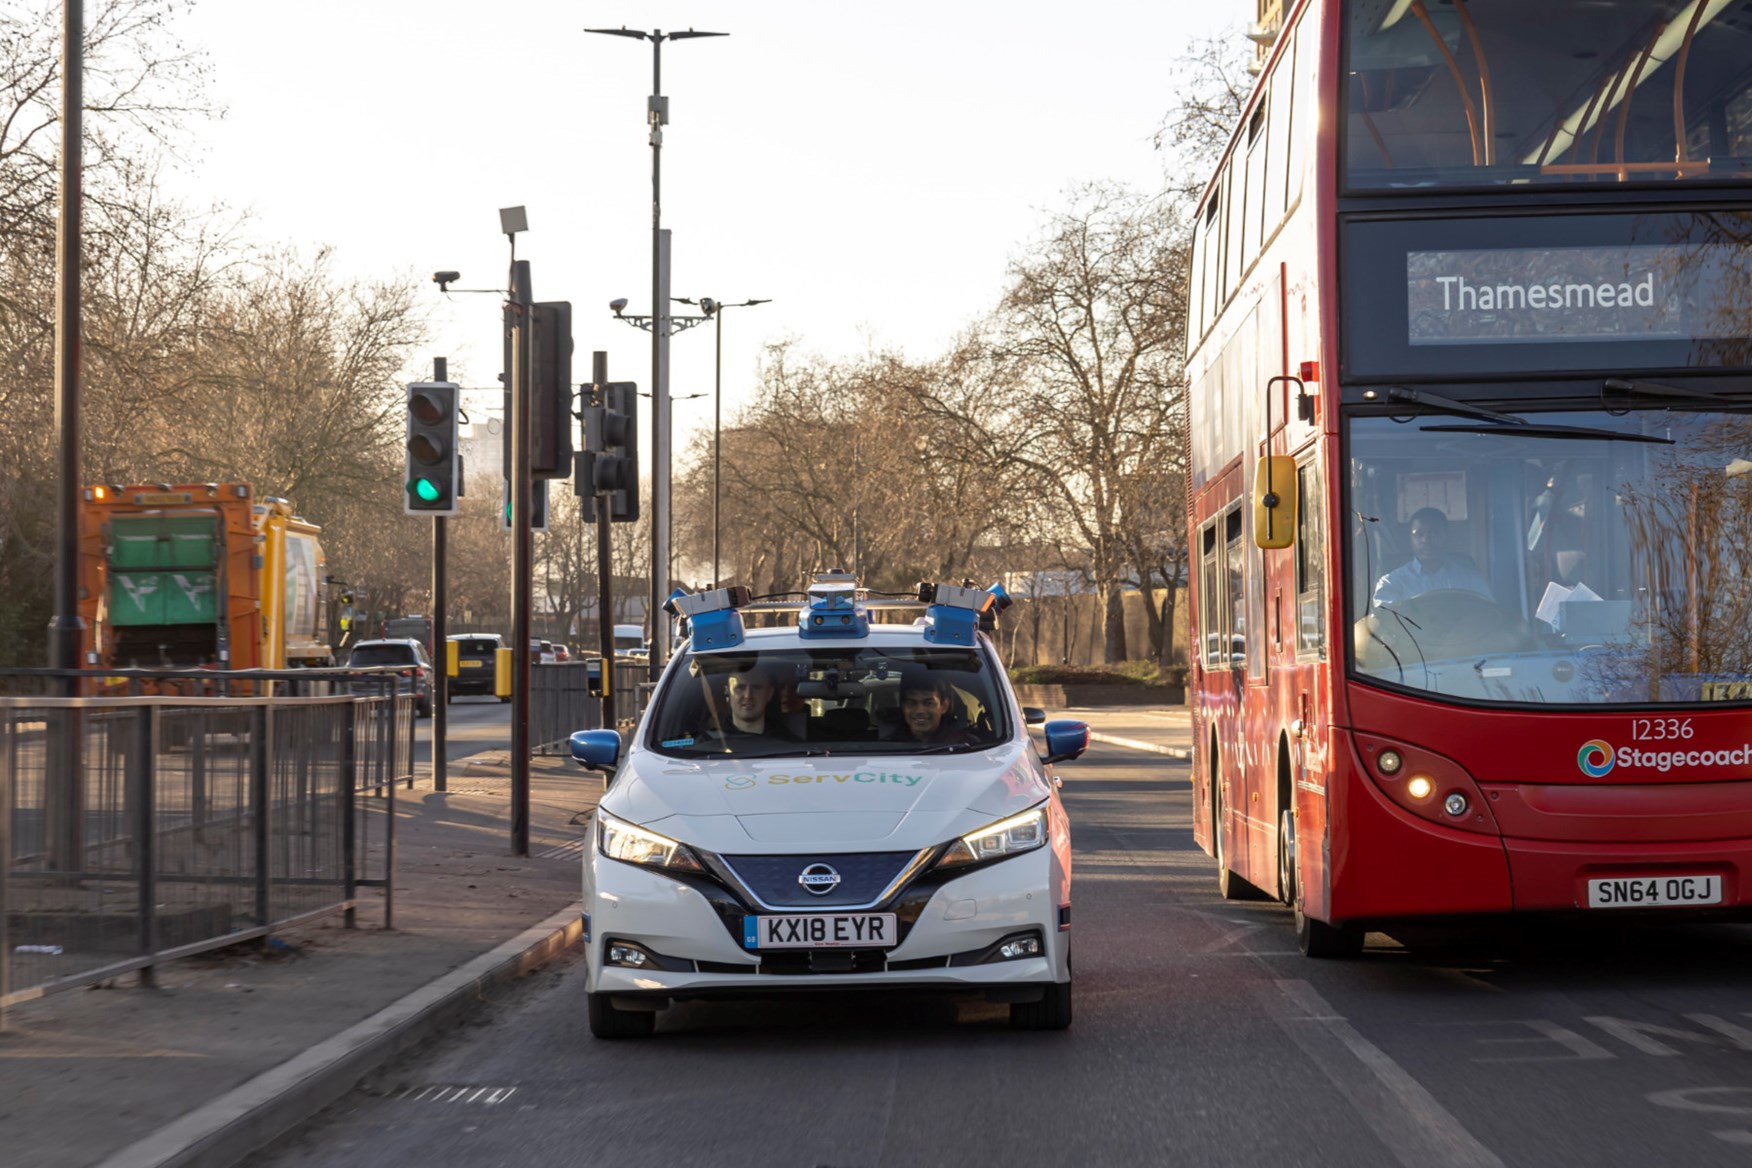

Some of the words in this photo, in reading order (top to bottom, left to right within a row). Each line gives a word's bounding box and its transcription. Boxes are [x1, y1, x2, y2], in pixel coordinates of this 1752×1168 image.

[1436, 273, 1654, 310] Thamesmead
[1632, 718, 1694, 740] 12336
[1617, 744, 1752, 772] Stagecoach
[768, 772, 923, 787] ServCity
[1598, 880, 1660, 903] SN64
[1666, 878, 1712, 900] OGJ
[768, 918, 826, 943] KX18
[834, 917, 884, 941] EYR
